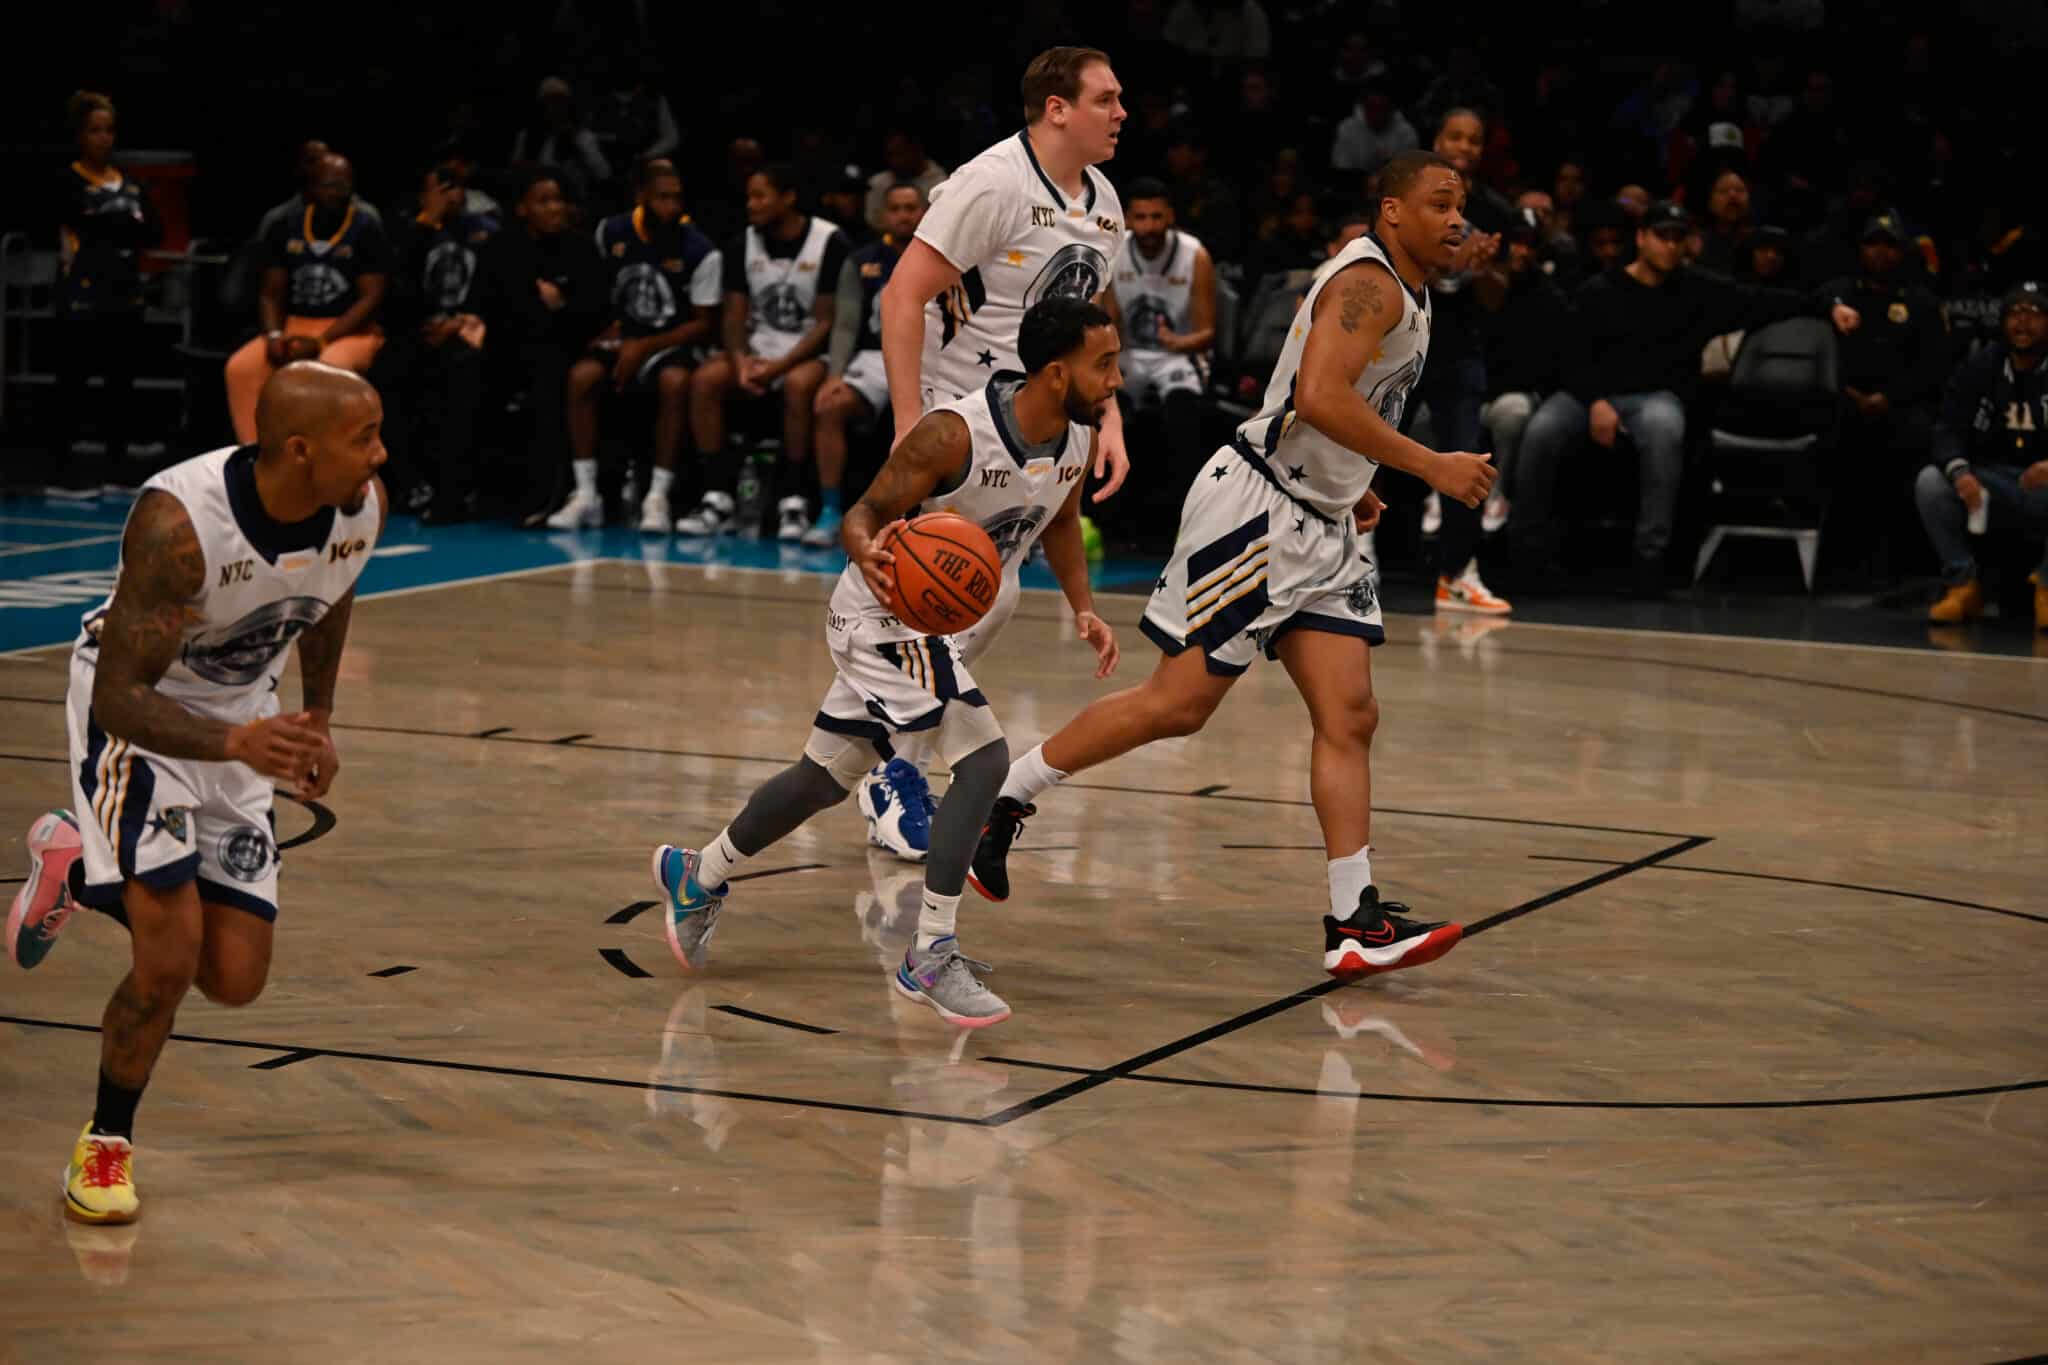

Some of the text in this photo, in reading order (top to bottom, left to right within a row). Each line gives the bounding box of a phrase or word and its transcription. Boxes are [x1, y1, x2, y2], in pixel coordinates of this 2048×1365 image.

[1032, 206, 1056, 227] NYC
[981, 469, 1010, 488] NYC
[219, 560, 254, 587] NYC
[934, 549, 970, 582] THE
